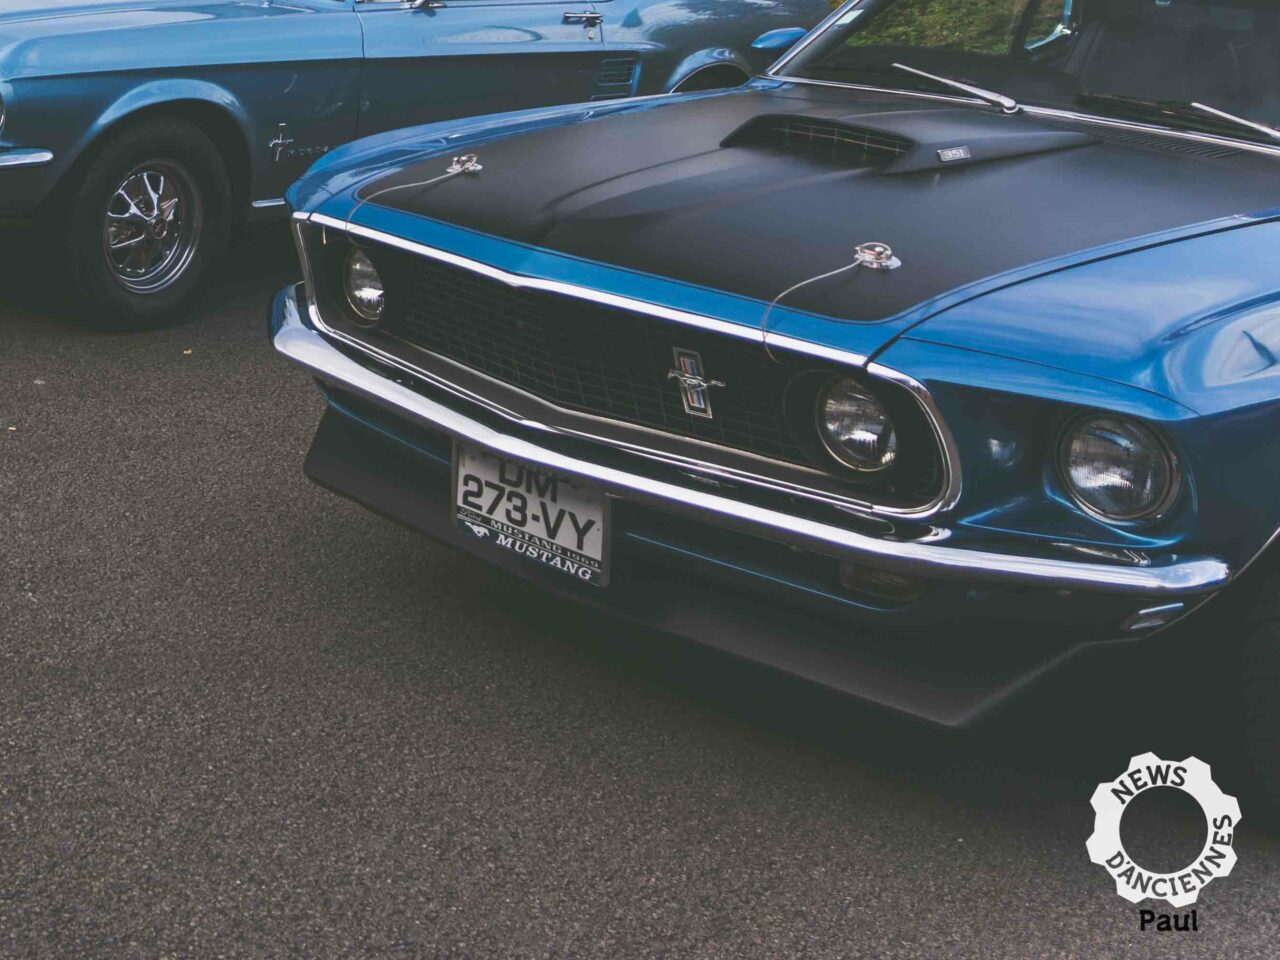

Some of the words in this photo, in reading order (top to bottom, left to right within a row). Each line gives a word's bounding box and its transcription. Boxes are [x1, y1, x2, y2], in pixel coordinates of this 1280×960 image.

[462, 473, 596, 552] 273-VY
[490, 519, 563, 554] MUSTANG
[567, 550, 599, 569] 1969
[495, 532, 593, 581] MUSTANG
